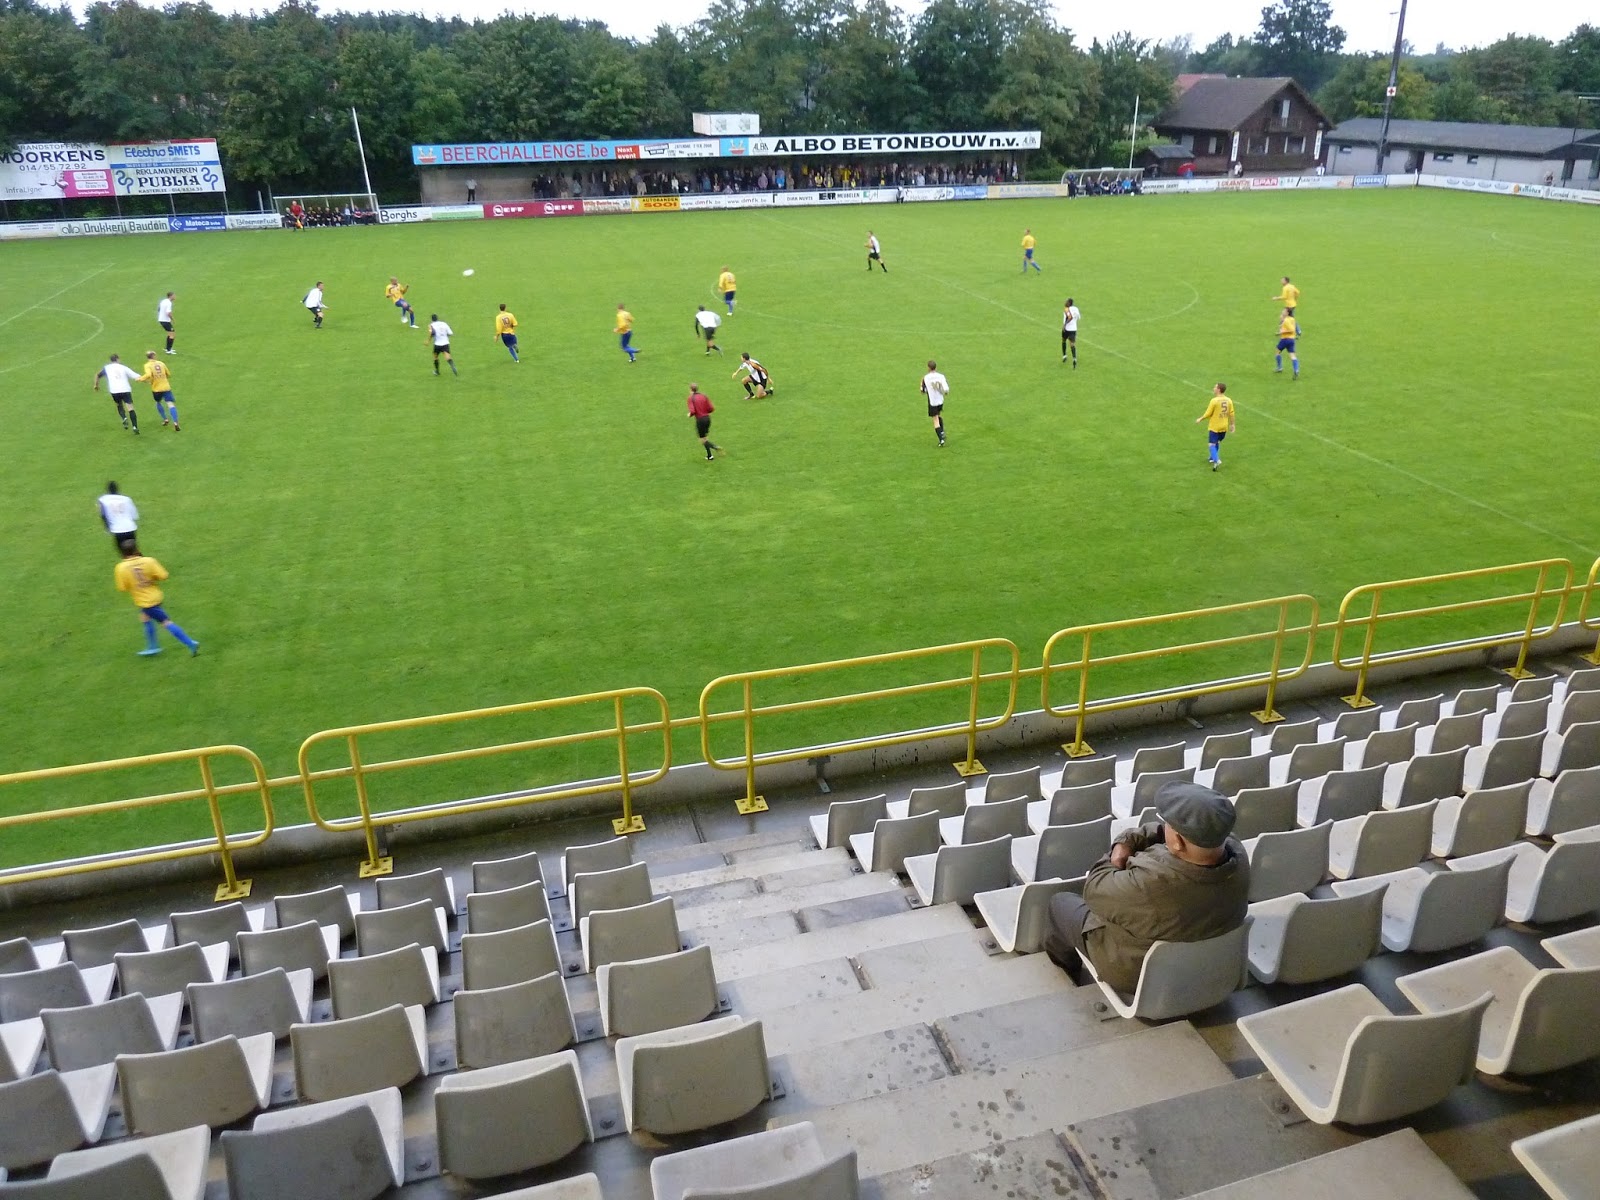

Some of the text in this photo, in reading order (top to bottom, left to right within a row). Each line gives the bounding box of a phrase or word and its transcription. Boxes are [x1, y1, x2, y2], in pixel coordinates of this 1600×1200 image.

[17, 143, 82, 151] RANDSTOFFEN
[773, 135, 1019, 152] ALBO BETONBOUW n.v.
[0, 149, 106, 164] MOORKENS
[124, 145, 201, 157] Electro SMETS
[442, 144, 608, 162] BEERCHALLENGE.be
[19, 163, 87, 172] 014/55.72.92
[135, 167, 199, 176] REKLAMEWERKEN
[137, 175, 201, 188] PUBLIA
[380, 210, 418, 222] Borghs
[84, 222, 127, 233] Drukkerij
[154, 364, 162, 375] 9
[1221, 402, 1228, 413] 5
